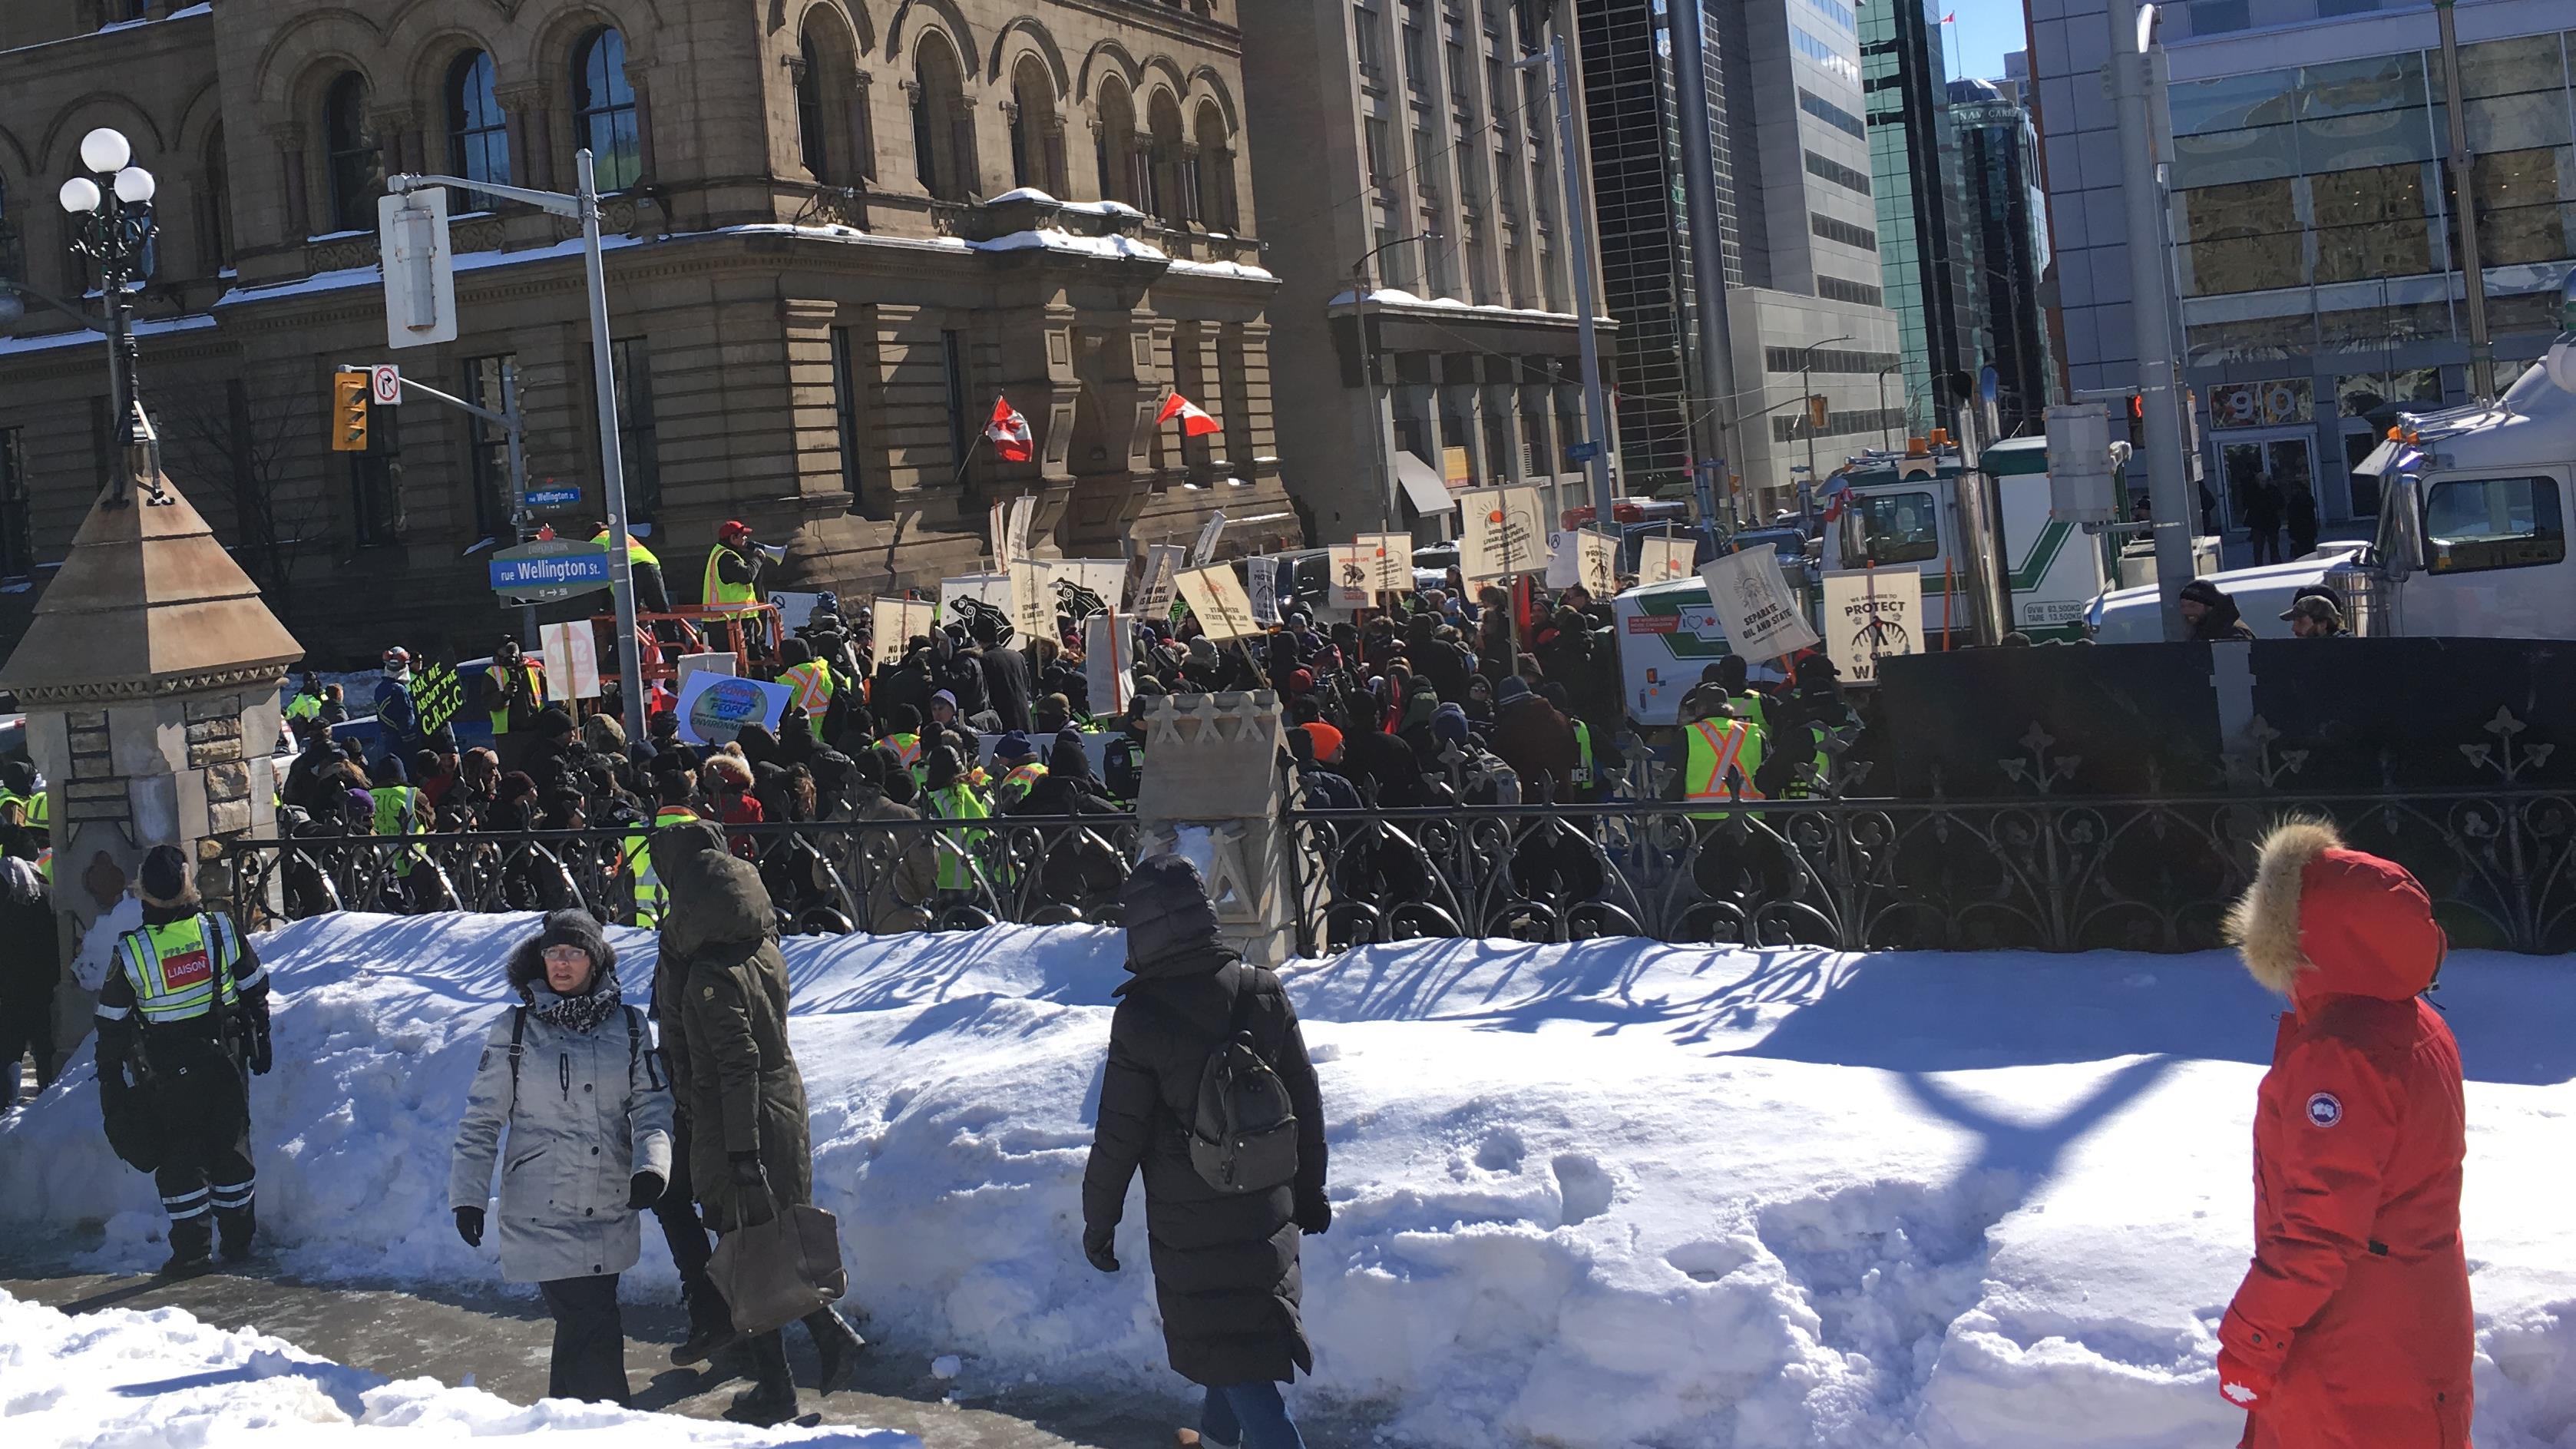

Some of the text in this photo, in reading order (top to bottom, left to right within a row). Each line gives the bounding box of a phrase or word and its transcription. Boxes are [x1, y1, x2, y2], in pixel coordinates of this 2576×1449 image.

[1959, 111, 1983, 121] NAV
[2230, 387, 2295, 419] 90
[536, 491, 569, 502] Wellington
[501, 560, 600, 581] rue Wellington St.
[1154, 585, 1168, 594] ONE
[1139, 596, 1146, 605] IS
[1744, 603, 1779, 626] SEPARATE
[1844, 601, 1906, 617] PROTECT
[2027, 606, 2044, 614] GVW
[1742, 628, 1756, 640] OIL
[1756, 620, 1771, 633] AND
[1771, 608, 1793, 625] STATE
[888, 643, 909, 654] NO ON
[412, 662, 441, 697] ASK ME
[416, 668, 458, 715] ABOUT THE
[710, 702, 752, 716] PEOPLE
[1571, 769, 1589, 782] ICE
[167, 960, 207, 978] LIAISON
